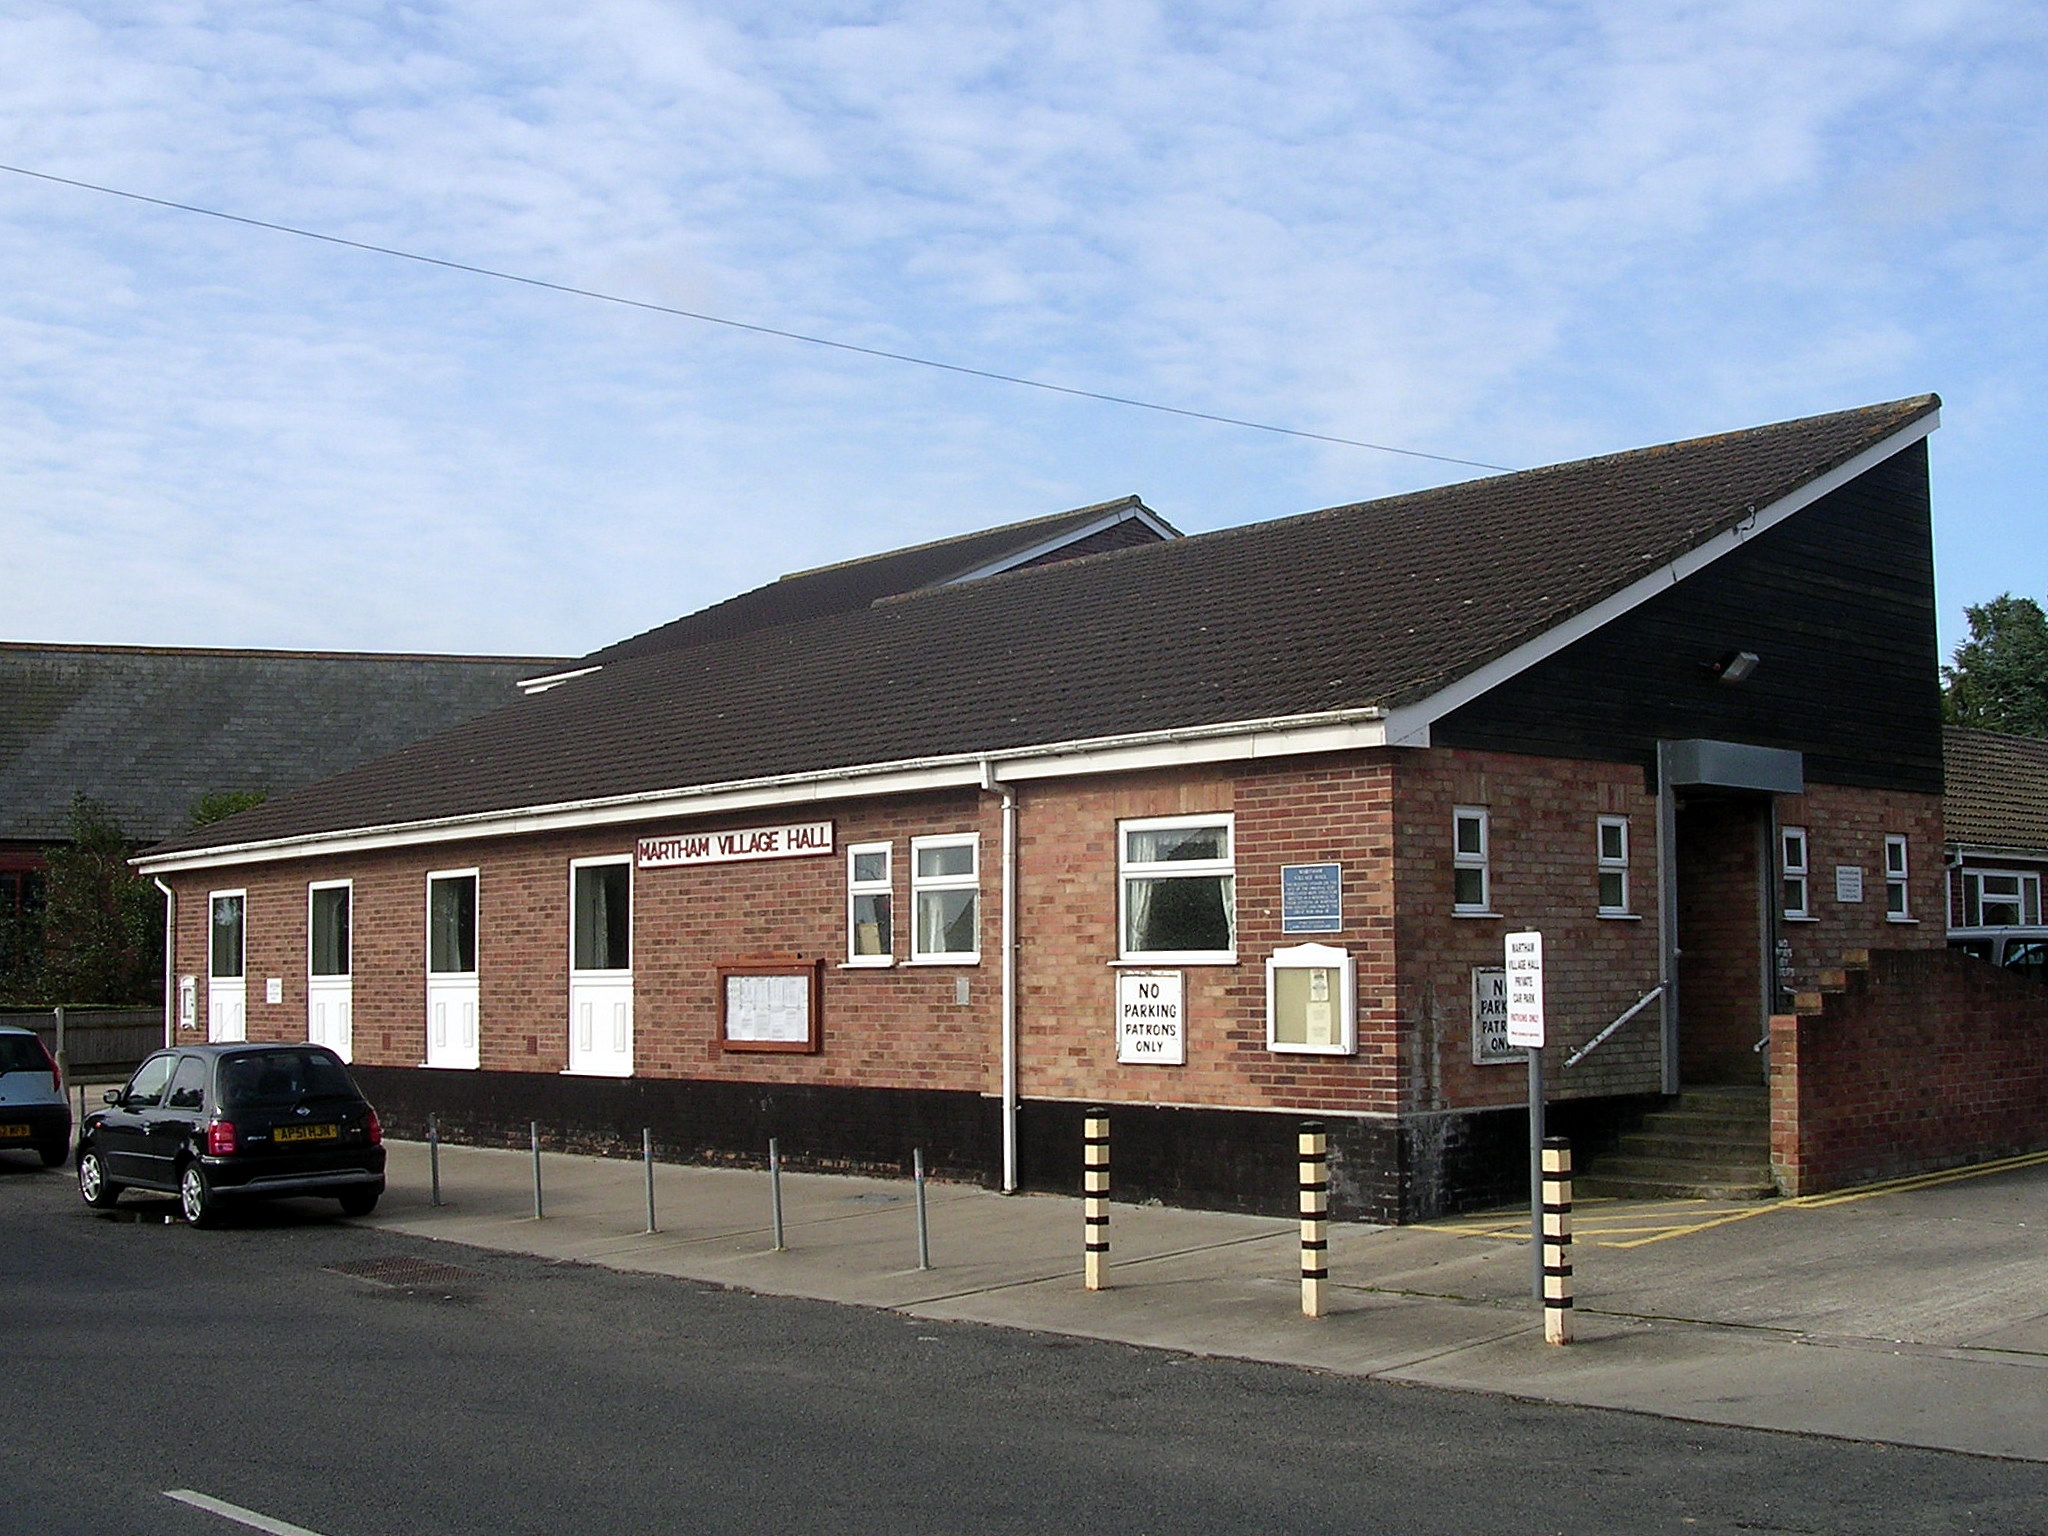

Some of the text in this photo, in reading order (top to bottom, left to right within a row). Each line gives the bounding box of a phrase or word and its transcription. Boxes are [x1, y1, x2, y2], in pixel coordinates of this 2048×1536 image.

[639, 826, 830, 861] MARTHAM VILLAGE HALL
[1139, 983, 1160, 999] NO
[1493, 979, 1507, 996] N
[1124, 1003, 1177, 1018] PARKING
[1481, 1000, 1508, 1015] PARK
[1482, 1020, 1508, 1034] PATR
[1136, 1040, 1163, 1052] ONLY
